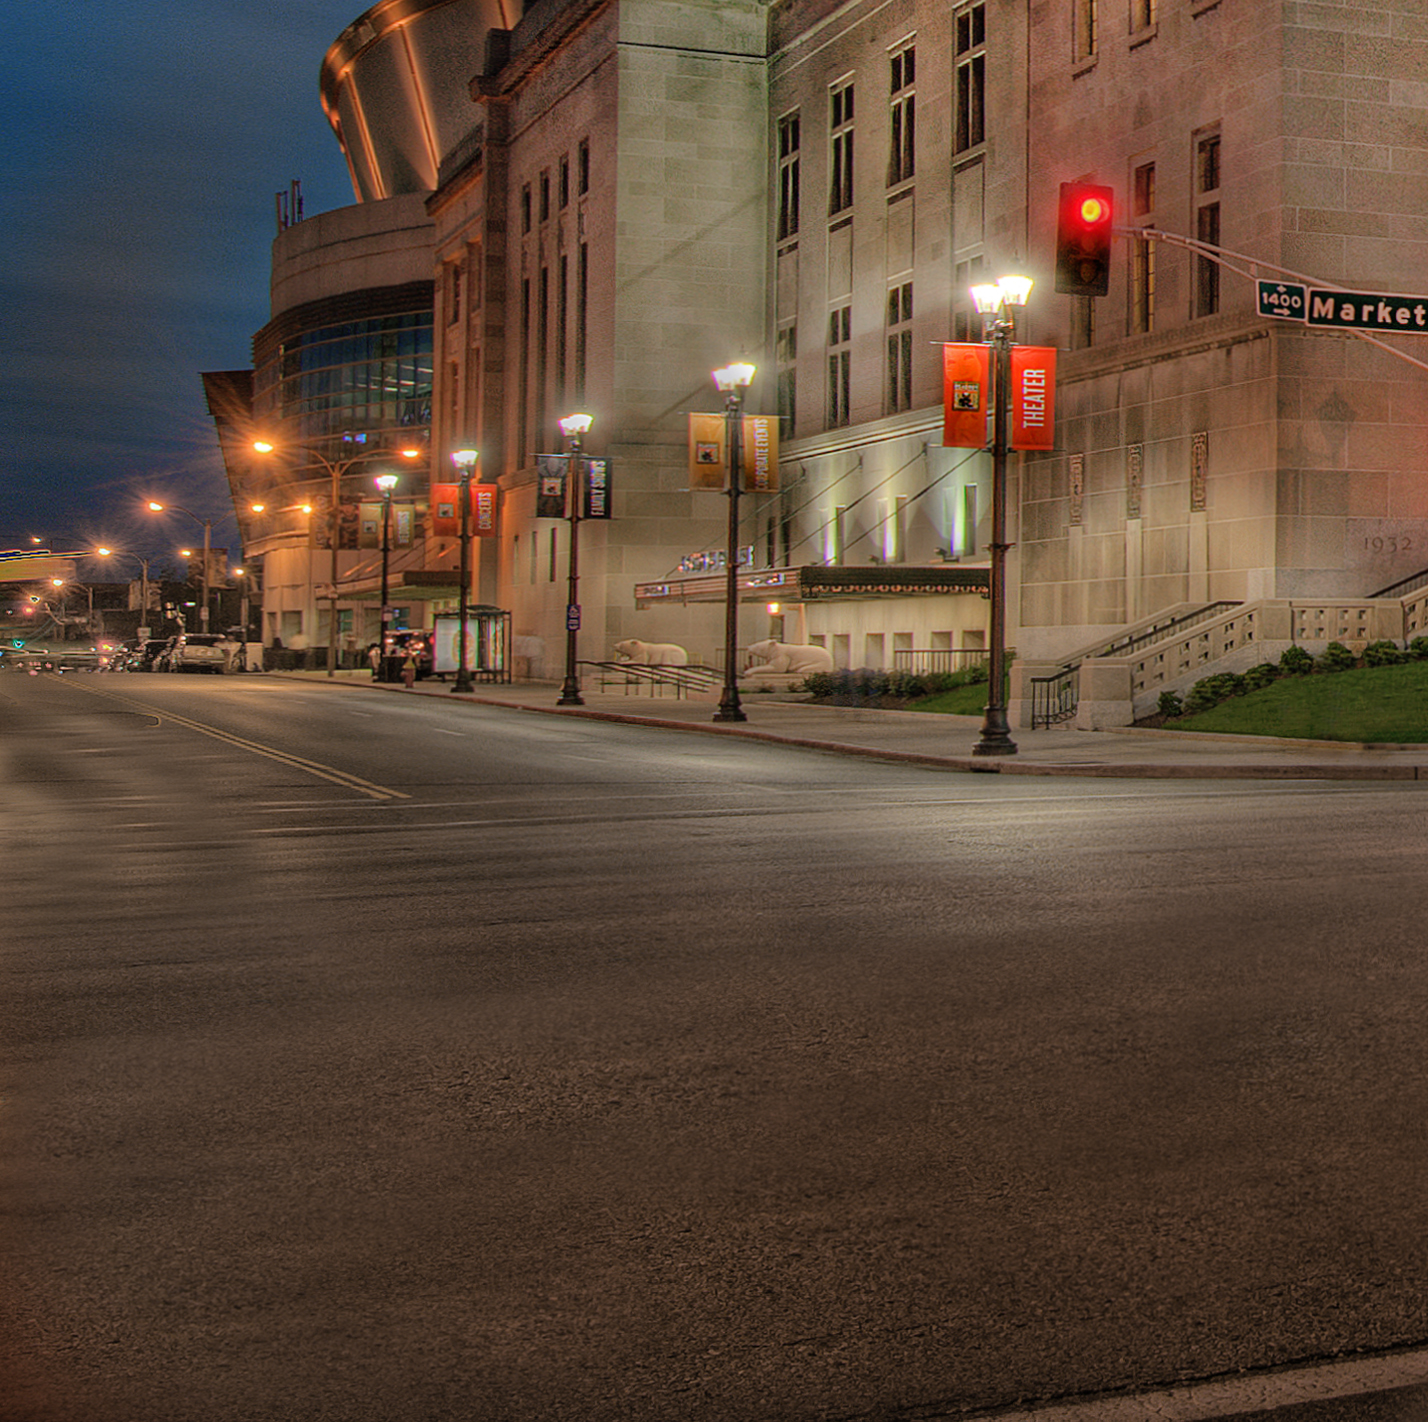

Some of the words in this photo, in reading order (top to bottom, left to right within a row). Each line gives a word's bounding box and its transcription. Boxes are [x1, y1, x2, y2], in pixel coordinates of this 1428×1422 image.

[1262, 292, 1301, 308] 1400
[1312, 296, 1426, 326] Market
[1022, 368, 1046, 428] THEATER
[1363, 536, 1412, 554] 1932
